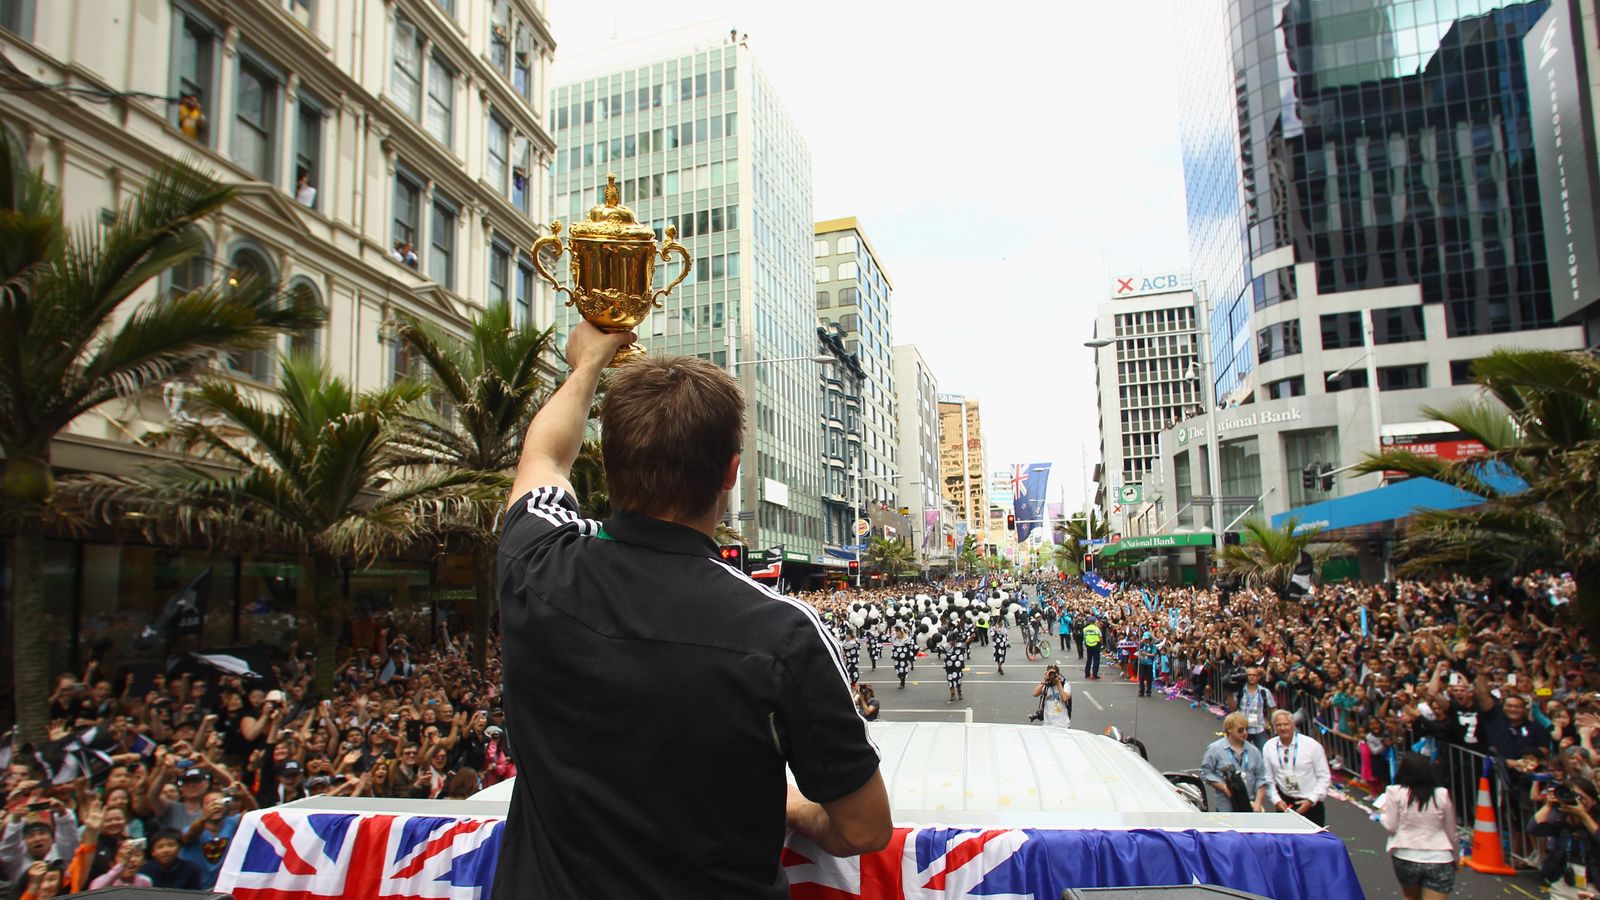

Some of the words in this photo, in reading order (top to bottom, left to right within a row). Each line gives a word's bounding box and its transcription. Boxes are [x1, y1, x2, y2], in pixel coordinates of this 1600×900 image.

[1557, 154, 1572, 236] FITNESS
[1567, 242, 1580, 300] TOWER
[1140, 274, 1178, 291] ACB
[1188, 427, 1205, 440] The
[1215, 413, 1257, 432] ational
[1261, 408, 1302, 424] Bank
[1127, 538, 1152, 549] National
[1153, 537, 1176, 546] Bank
[1458, 715, 1478, 743] 7
